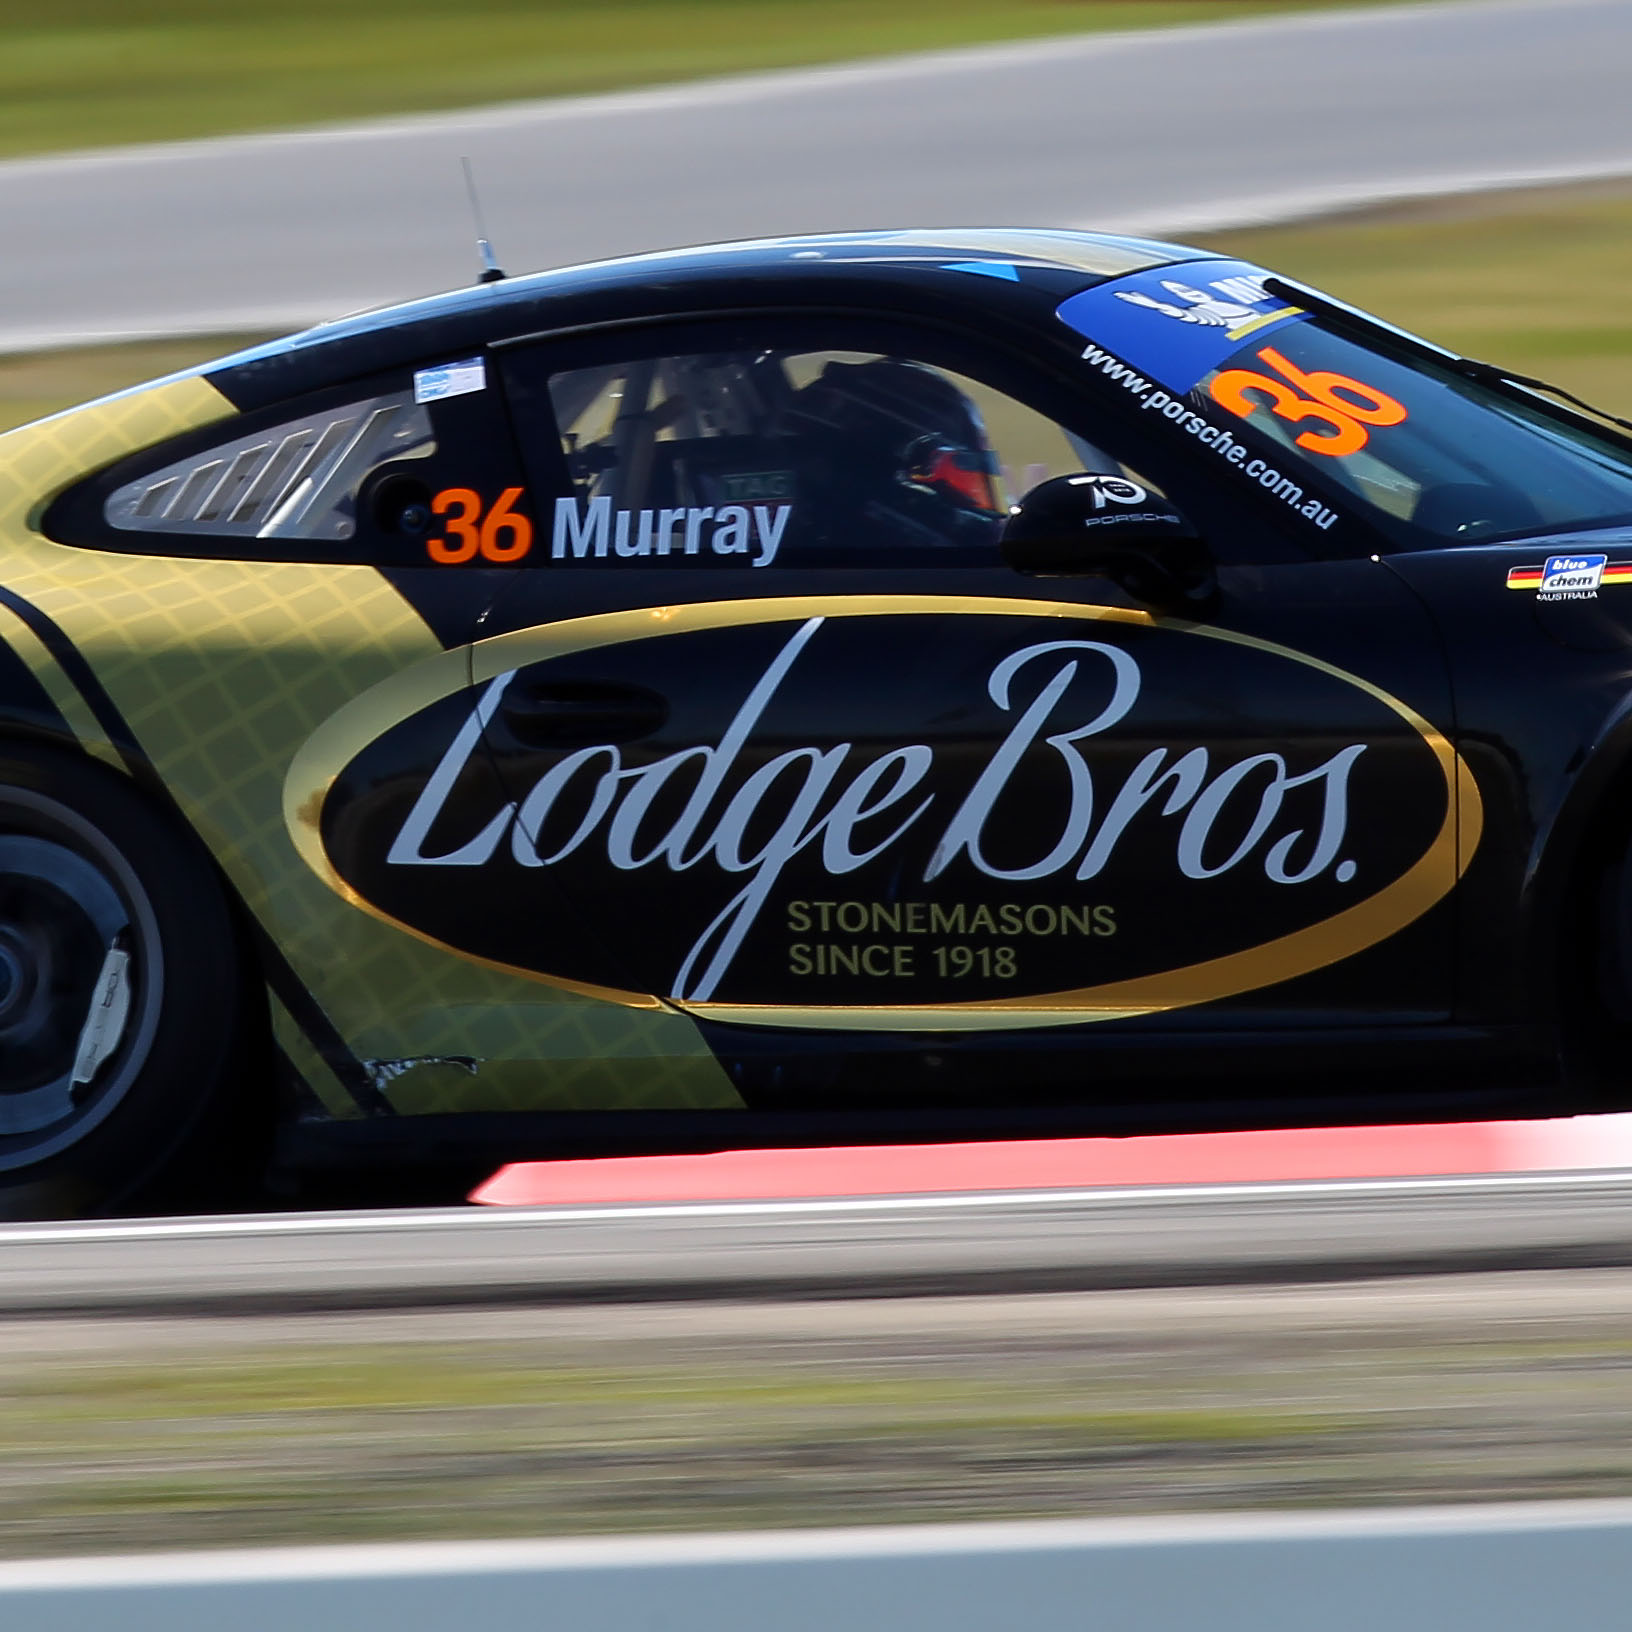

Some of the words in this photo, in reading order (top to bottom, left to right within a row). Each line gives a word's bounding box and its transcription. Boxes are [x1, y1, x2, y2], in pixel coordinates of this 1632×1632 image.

[1209, 346, 1408, 457] 36
[1081, 344, 1339, 530] www.porsche.com.au
[426, 487, 533, 564] 36
[552, 496, 792, 567] Murray
[1085, 513, 1180, 526] PORSCHE
[1549, 576, 1593, 588] chem
[1552, 559, 1588, 571] blue
[1539, 590, 1598, 602] AUSTRALIA
[386, 615, 936, 1002] Lodge
[922, 640, 1368, 884] Bros.
[787, 901, 1118, 936] STONEMASONS
[788, 943, 916, 976] SINCE
[932, 945, 1018, 978] 1918
